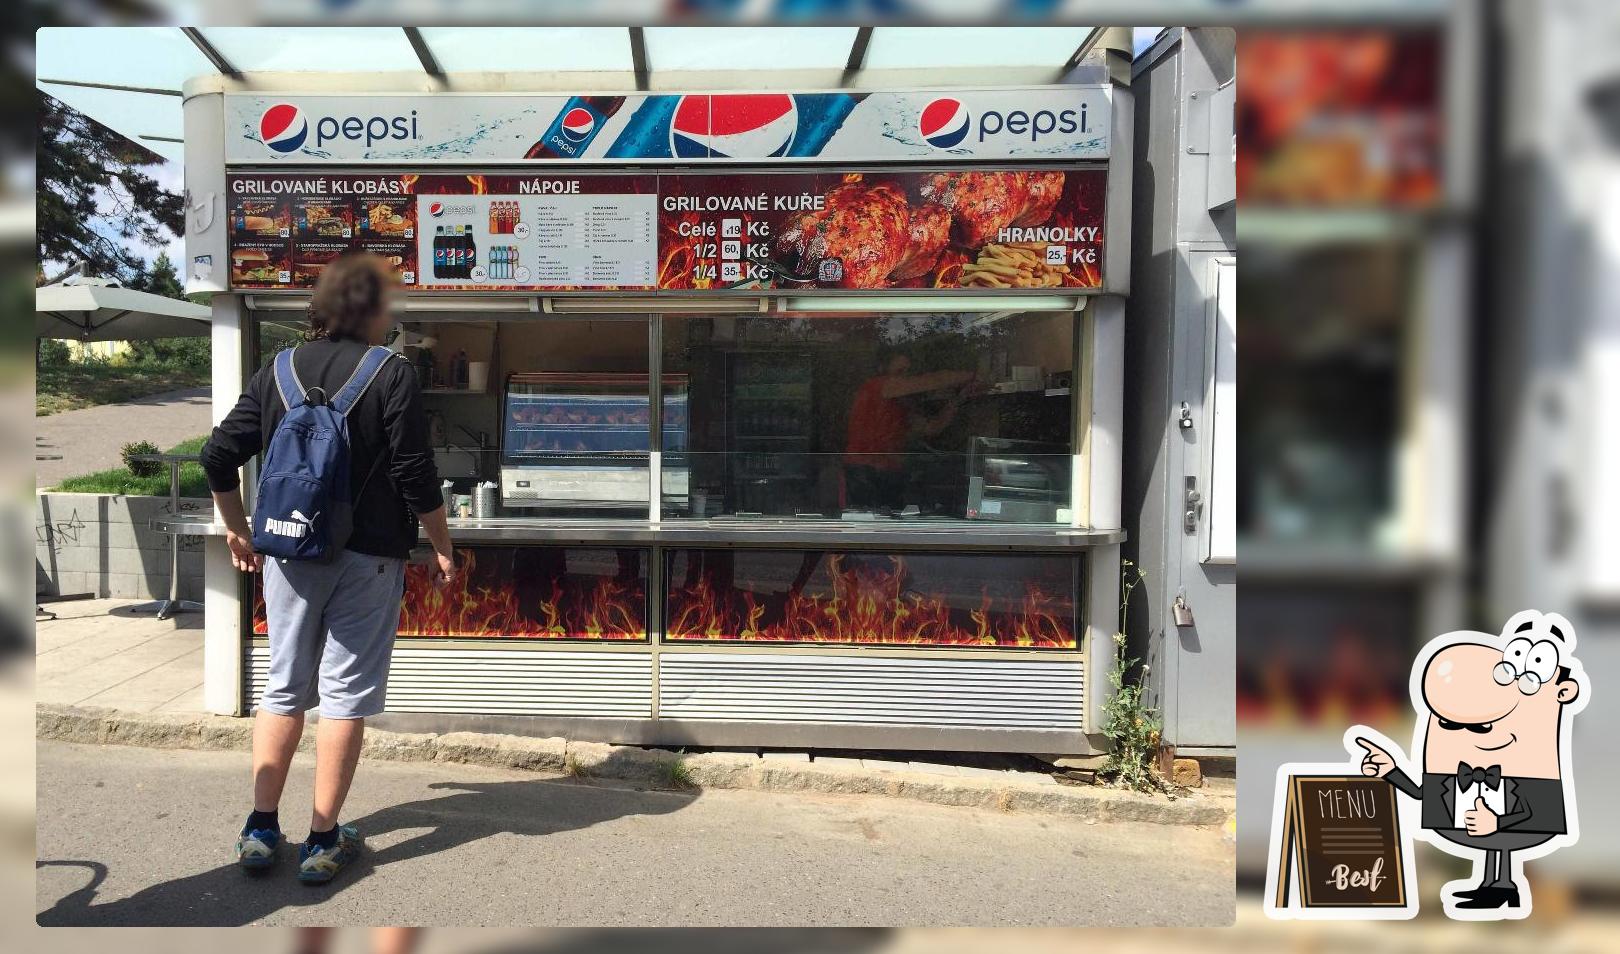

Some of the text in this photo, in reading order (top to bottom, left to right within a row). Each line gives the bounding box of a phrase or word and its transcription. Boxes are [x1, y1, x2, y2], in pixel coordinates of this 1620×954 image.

[317, 110, 418, 148] pepsi
[979, 102, 1088, 143] pepsi
[550, 135, 577, 155] pepsi
[232, 177, 412, 194] GRILOVANÉ KLOBÁSY
[519, 178, 580, 194] NÁPOJE
[663, 192, 825, 212] GRILOVANÉ KUŘE
[678, 221, 717, 237] Celé
[747, 221, 770, 237] Kč
[997, 226, 1099, 243] HRANOLKY
[693, 243, 717, 258] 1/2
[746, 243, 769, 258] Kč
[1072, 248, 1096, 264] Kč
[693, 265, 718, 280] 1/4
[746, 264, 769, 279] Kč
[264, 517, 307, 538] PUMA
